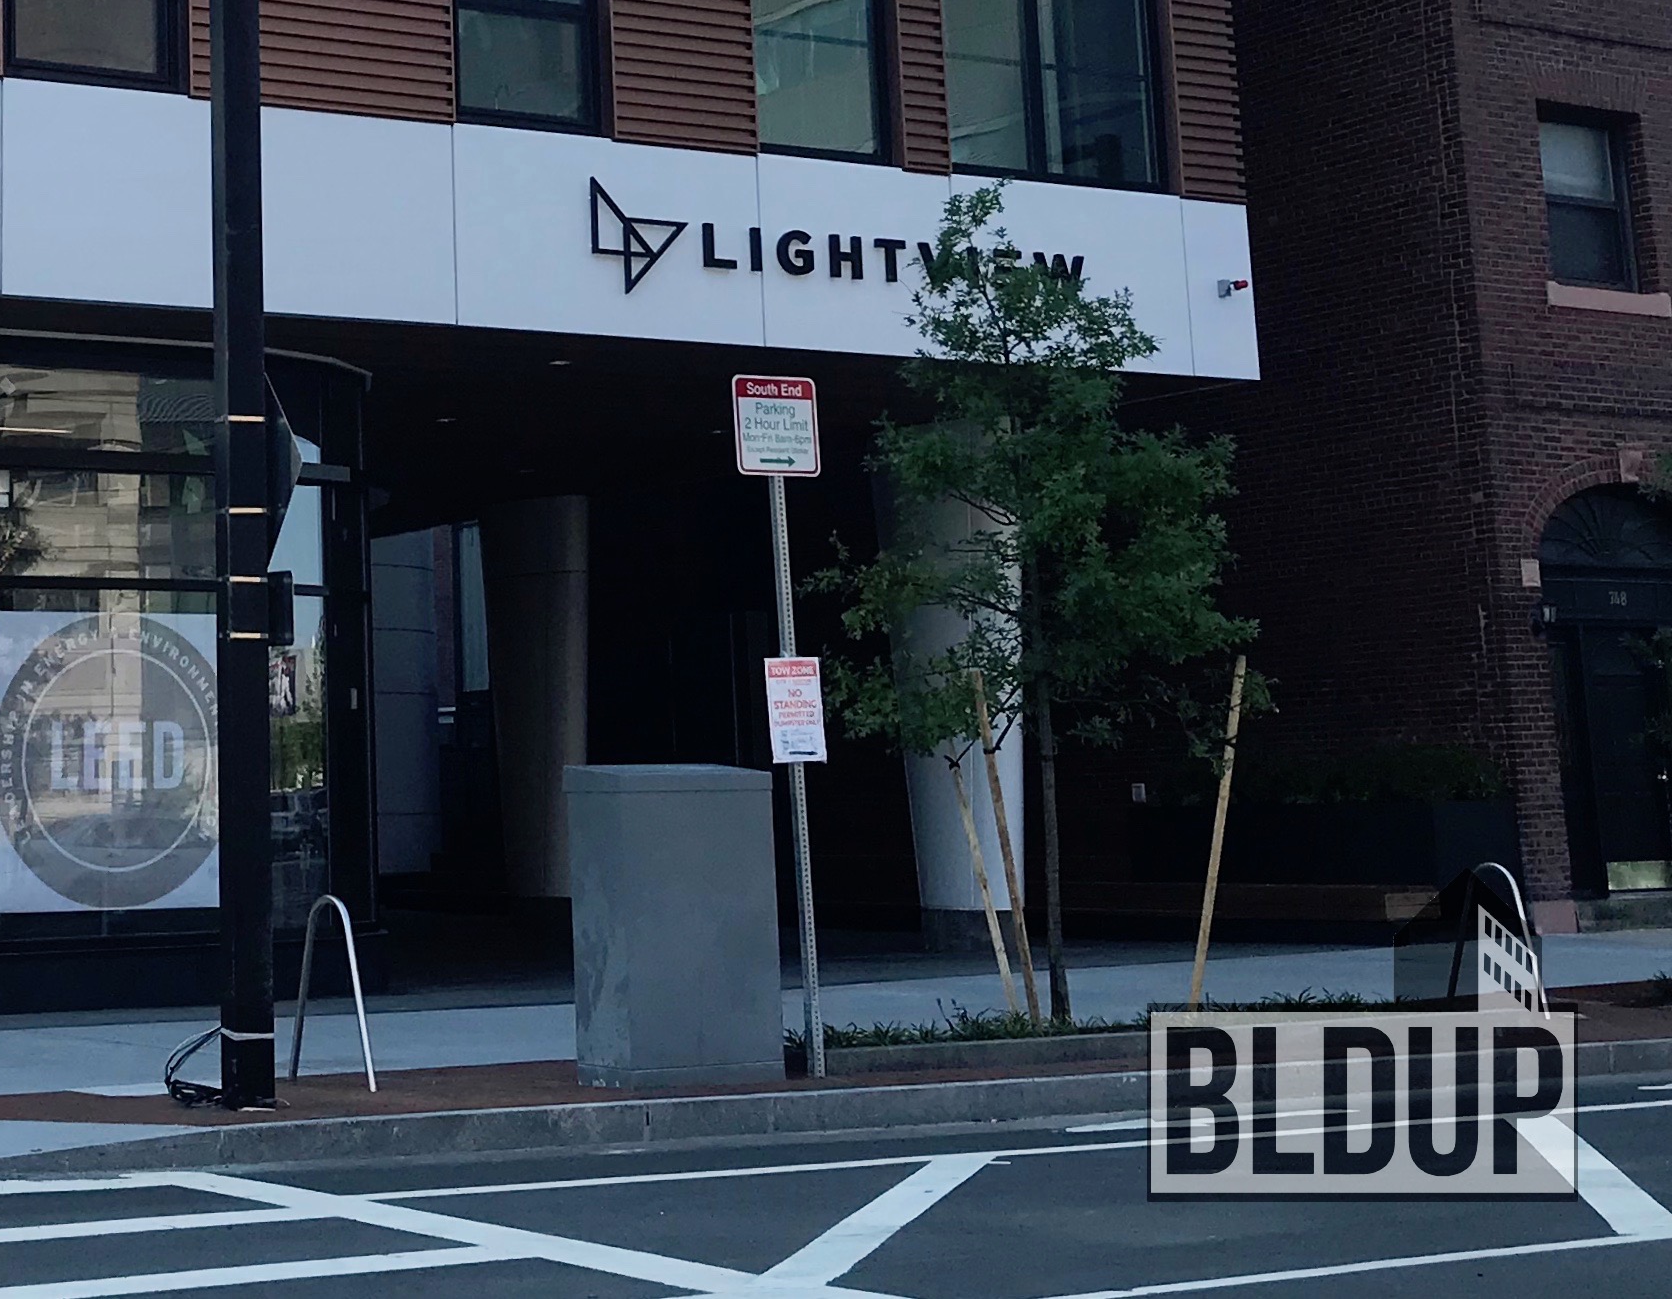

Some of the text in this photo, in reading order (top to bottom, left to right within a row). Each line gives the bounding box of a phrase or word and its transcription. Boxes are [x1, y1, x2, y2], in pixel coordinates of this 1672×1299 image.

[746, 382, 803, 397] South End
[755, 402, 796, 419] Parking
[744, 417, 809, 432] 2 Hour Limit
[1608, 591, 1627, 606] 748
[770, 666, 815, 676] TOW ZONE
[787, 688, 803, 698] NO
[773, 700, 817, 710] STANDING
[49, 718, 185, 792] LEED
